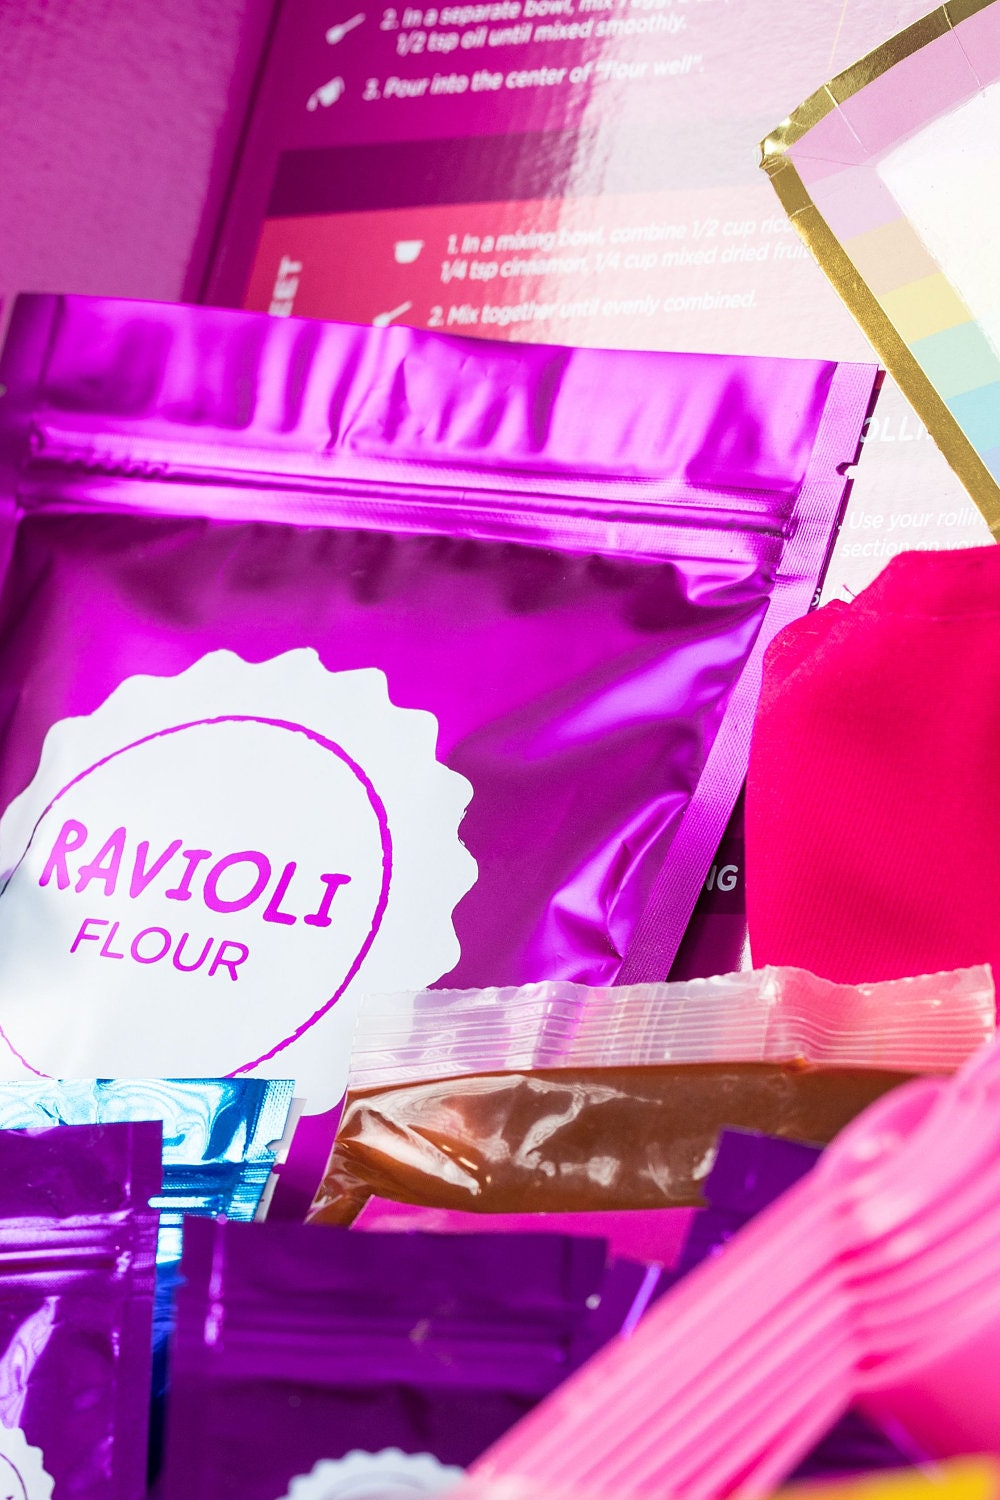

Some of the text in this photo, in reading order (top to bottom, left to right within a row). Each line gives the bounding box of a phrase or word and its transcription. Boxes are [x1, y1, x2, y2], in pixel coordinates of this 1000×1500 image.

[396, 12, 687, 56] 1/2 tsp oil until mixed smoothly.
[402, 6, 423, 28] In
[424, 8, 438, 27] a
[439, 1, 522, 27] separate
[362, 77, 381, 100] 3.
[383, 76, 430, 99] Pour
[429, 73, 470, 95] into
[470, 68, 504, 93] the
[505, 66, 567, 90] center
[569, 62, 592, 83] of
[460, 232, 481, 255] In
[481, 235, 495, 253] a
[495, 229, 556, 251] mixing
[609, 222, 687, 244] combine
[692, 217, 719, 240] 1/2
[722, 219, 757, 239] cup
[440, 257, 468, 285] 1/4
[468, 259, 499, 282] tsp
[624, 253, 658, 272] cup
[661, 246, 719, 268] mixed
[720, 243, 770, 264] dried
[427, 289, 757, 328] 2. Mix together until evenly combined.
[849, 511, 884, 529] Use
[888, 511, 934, 532] your
[38, 819, 352, 928] RAVIOLI
[70, 918, 250, 981] FLOUR
